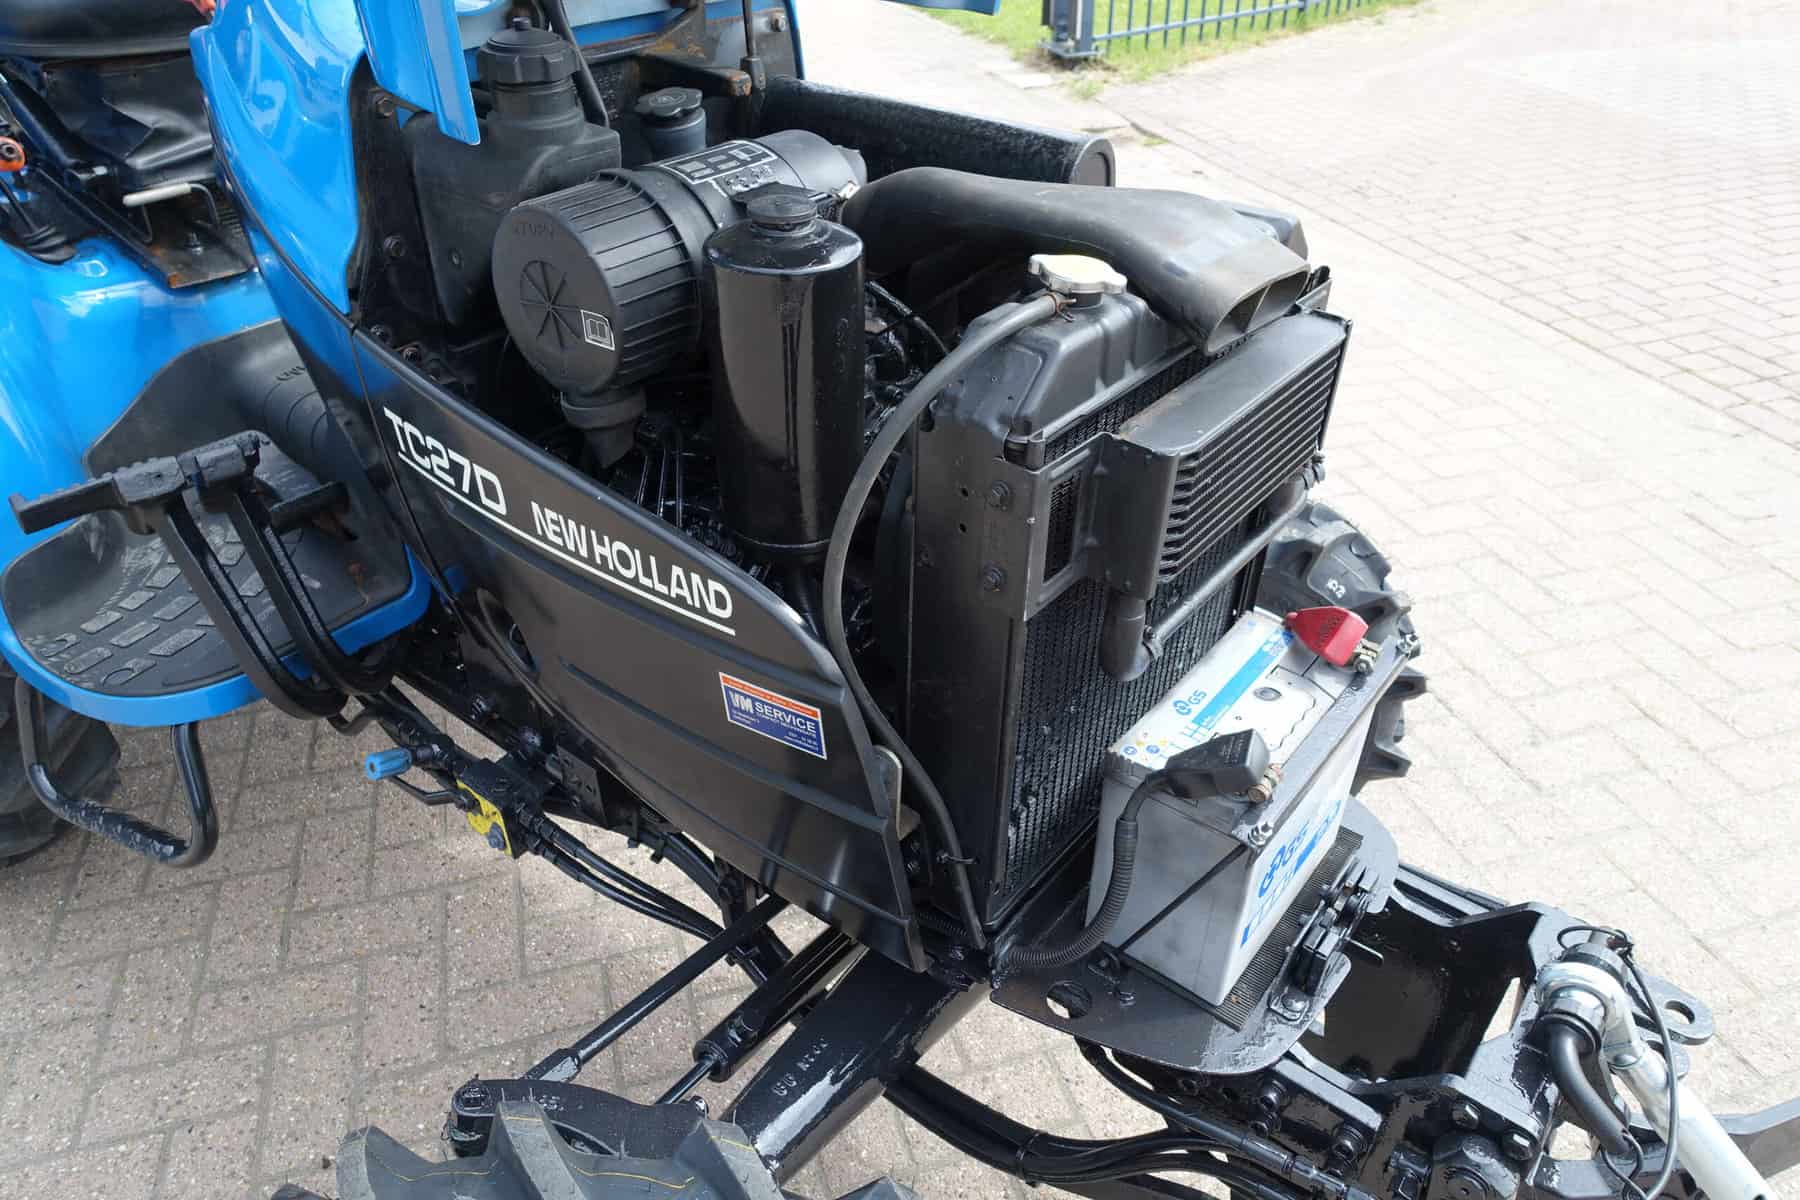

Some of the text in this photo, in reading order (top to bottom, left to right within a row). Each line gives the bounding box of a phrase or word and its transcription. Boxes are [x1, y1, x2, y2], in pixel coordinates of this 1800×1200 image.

[384, 407, 507, 516] TC27D
[530, 500, 734, 619] NEW HOLLAND
[754, 701, 817, 734] SERVICE
